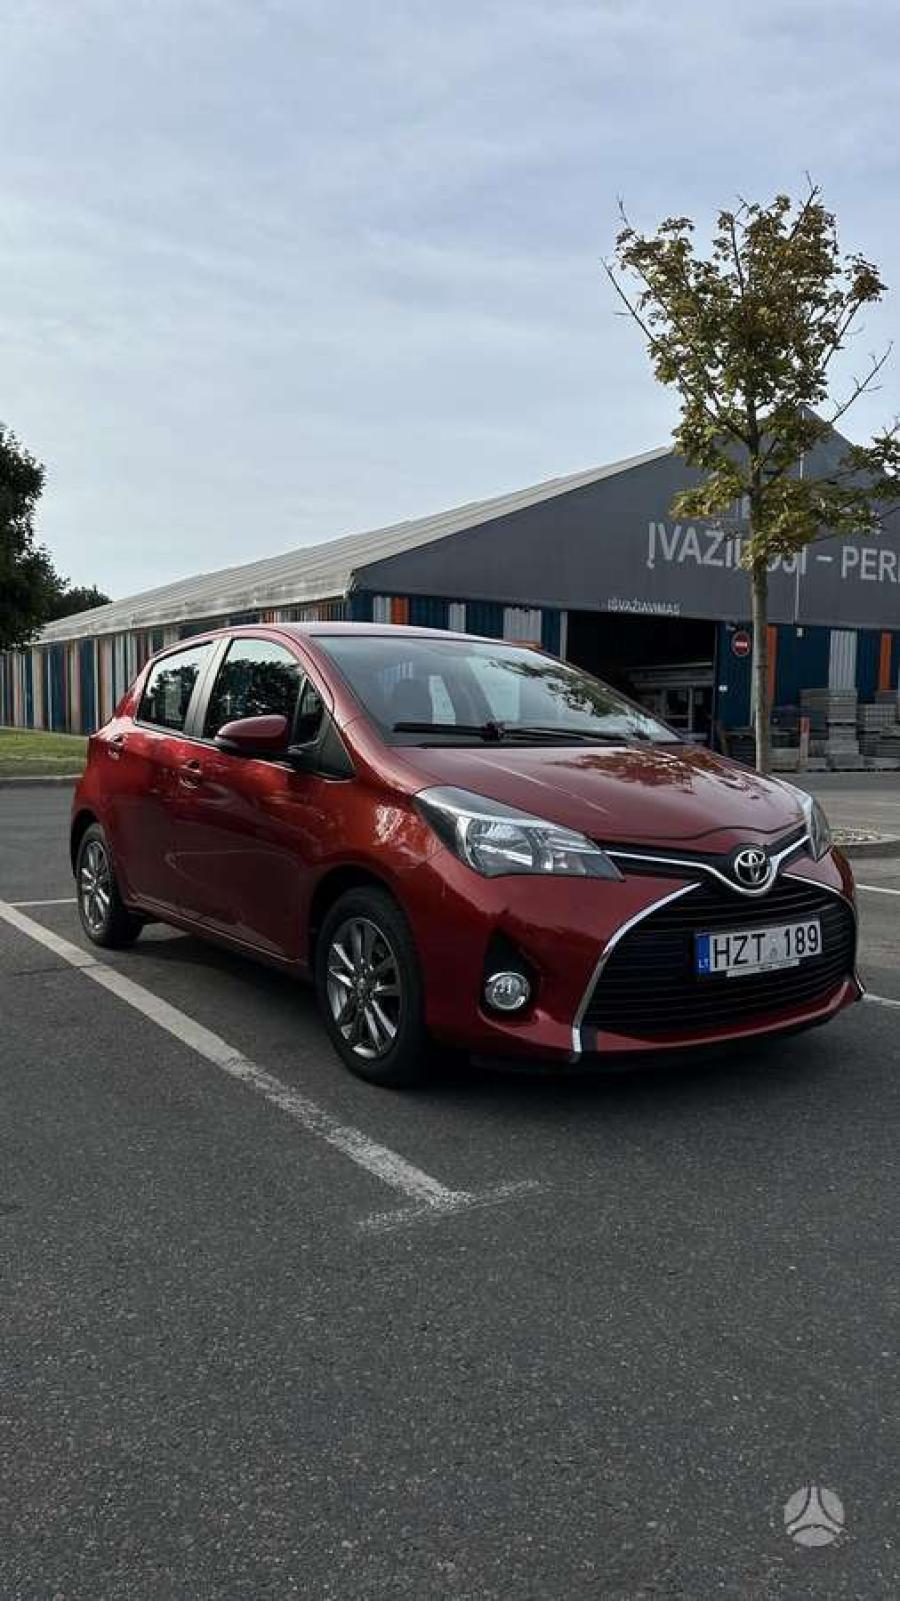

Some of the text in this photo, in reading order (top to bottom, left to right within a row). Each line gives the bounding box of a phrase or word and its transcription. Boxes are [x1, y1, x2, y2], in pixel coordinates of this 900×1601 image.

[841, 545, 900, 584] PER
[713, 933, 766, 968] HZT
[784, 924, 819, 957] 189
